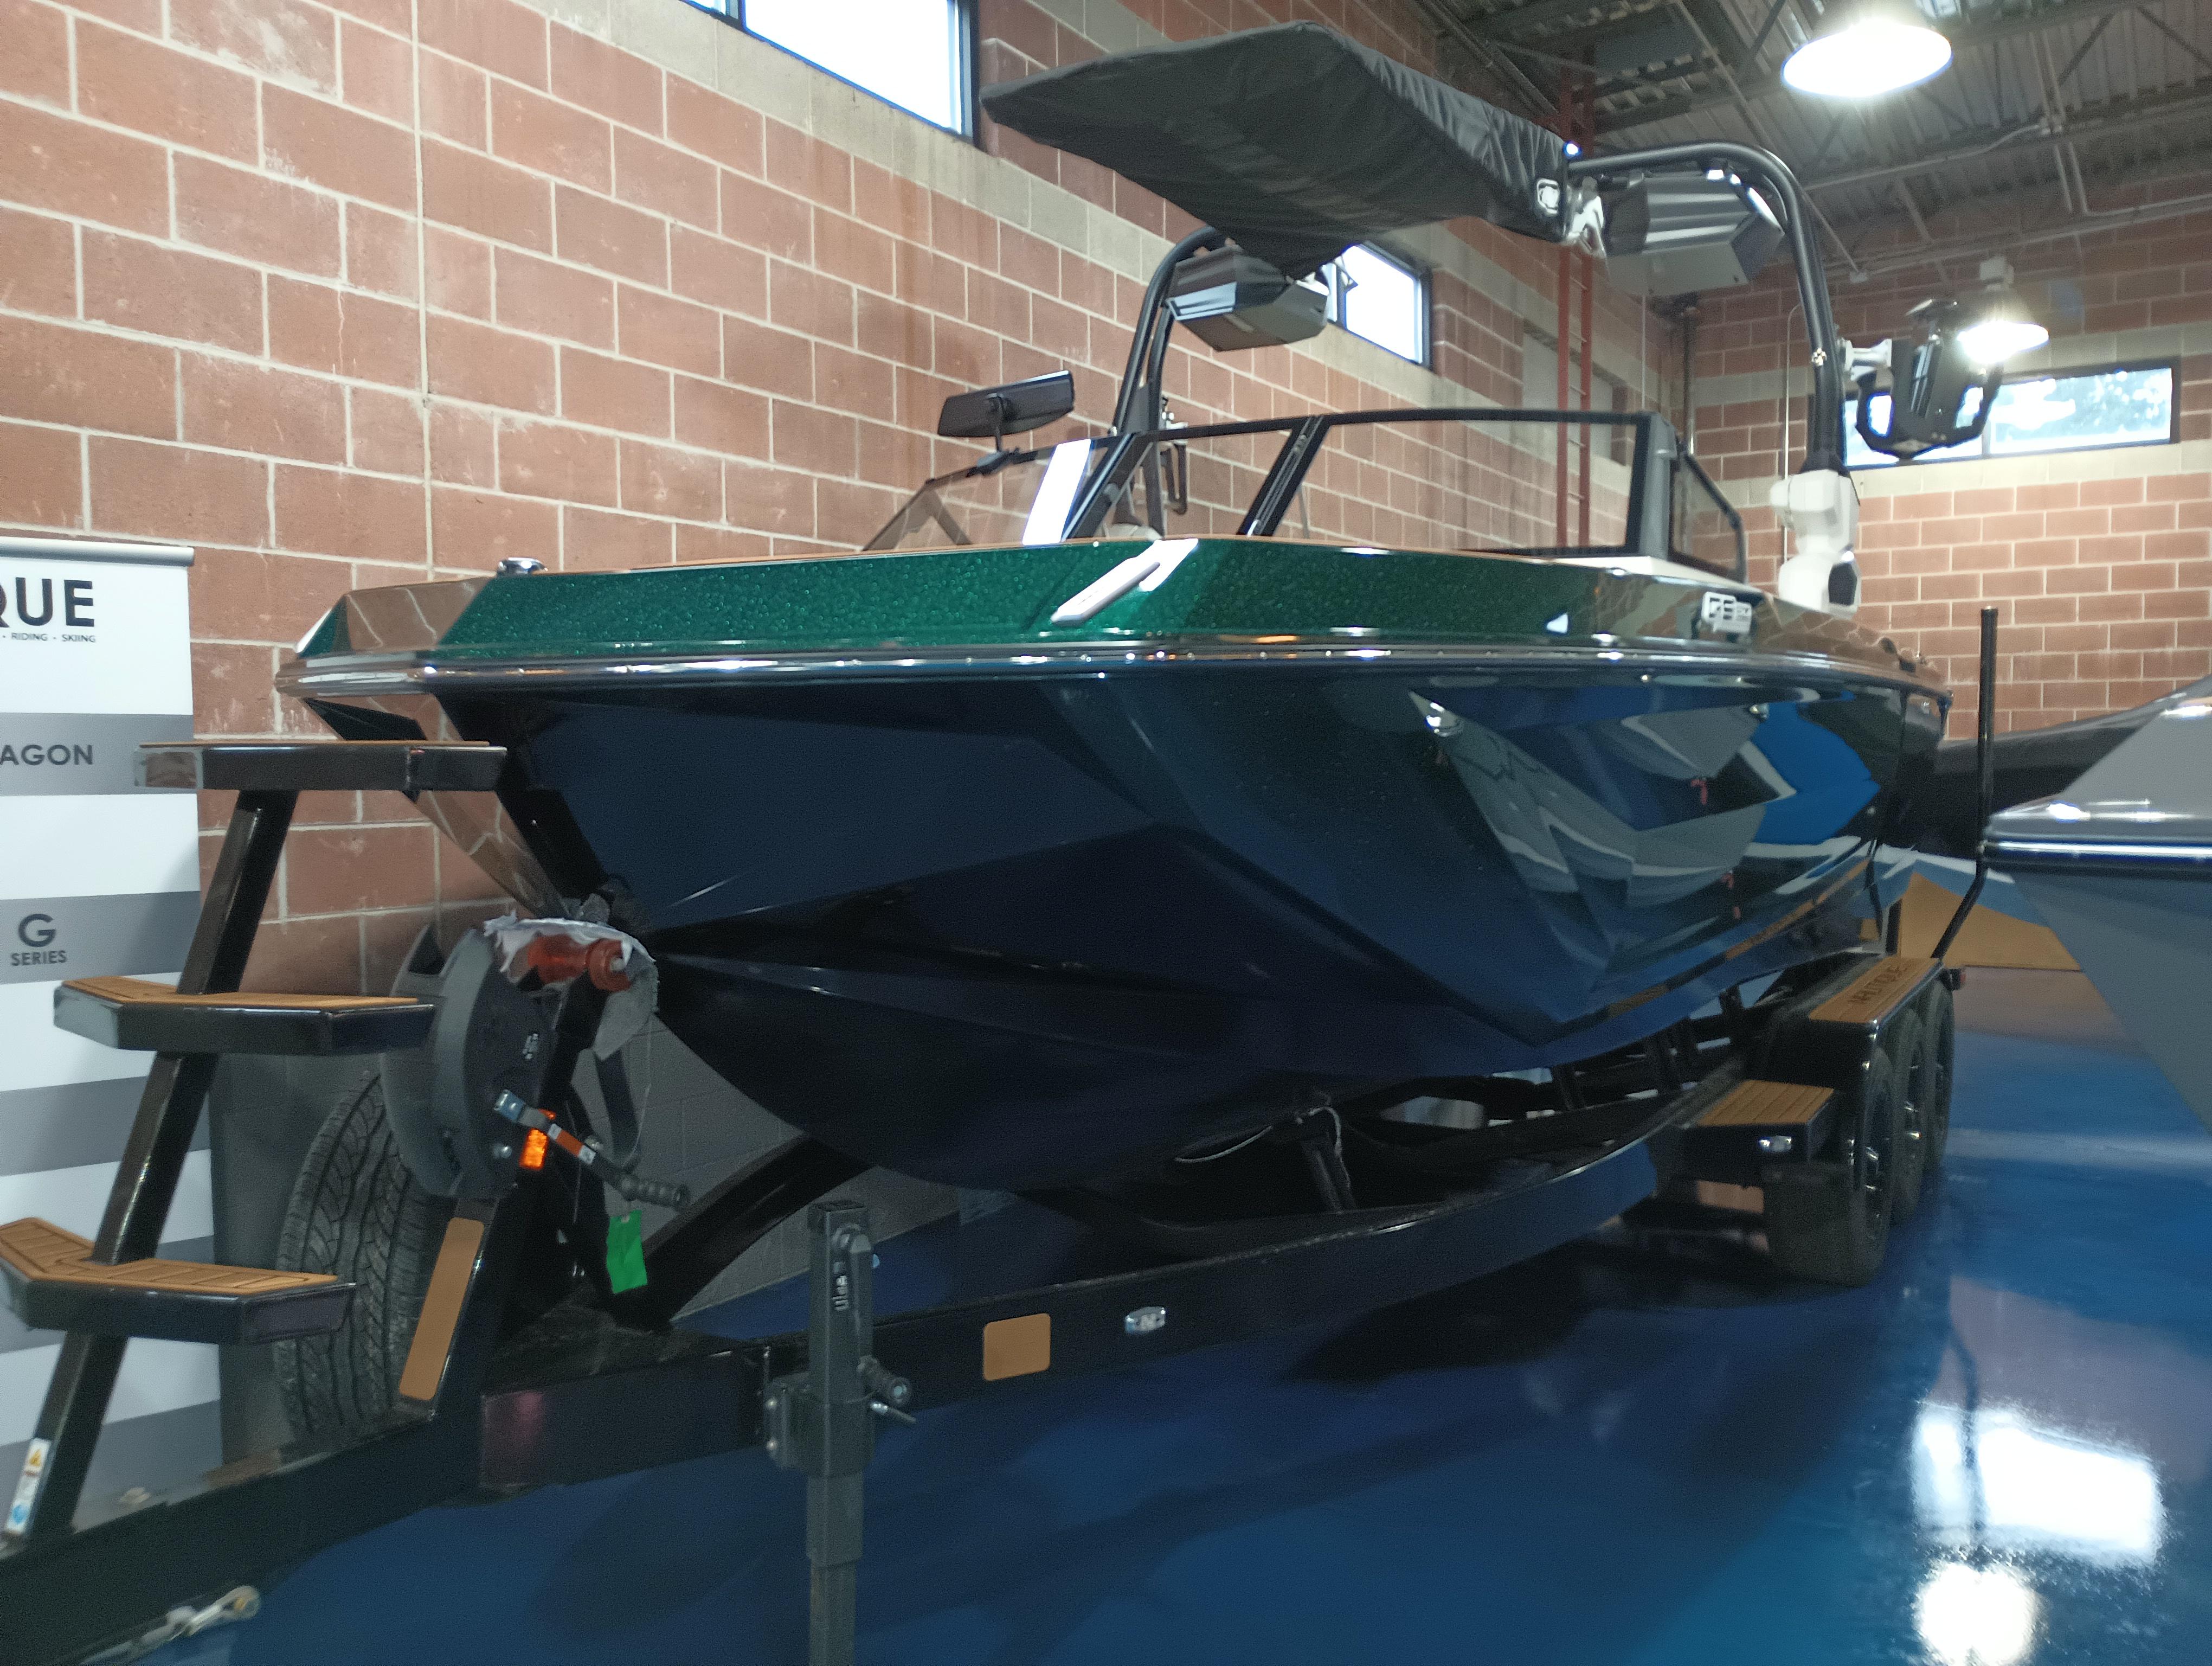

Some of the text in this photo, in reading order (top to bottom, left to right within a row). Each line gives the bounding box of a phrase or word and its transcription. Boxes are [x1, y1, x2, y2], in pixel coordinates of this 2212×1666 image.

[0, 577, 95, 628] UE
[11, 632, 96, 643] RIDING SKIING
[0, 744, 93, 766] AGON
[18, 913, 56, 947] G
[11, 950, 67, 966] SERIES
